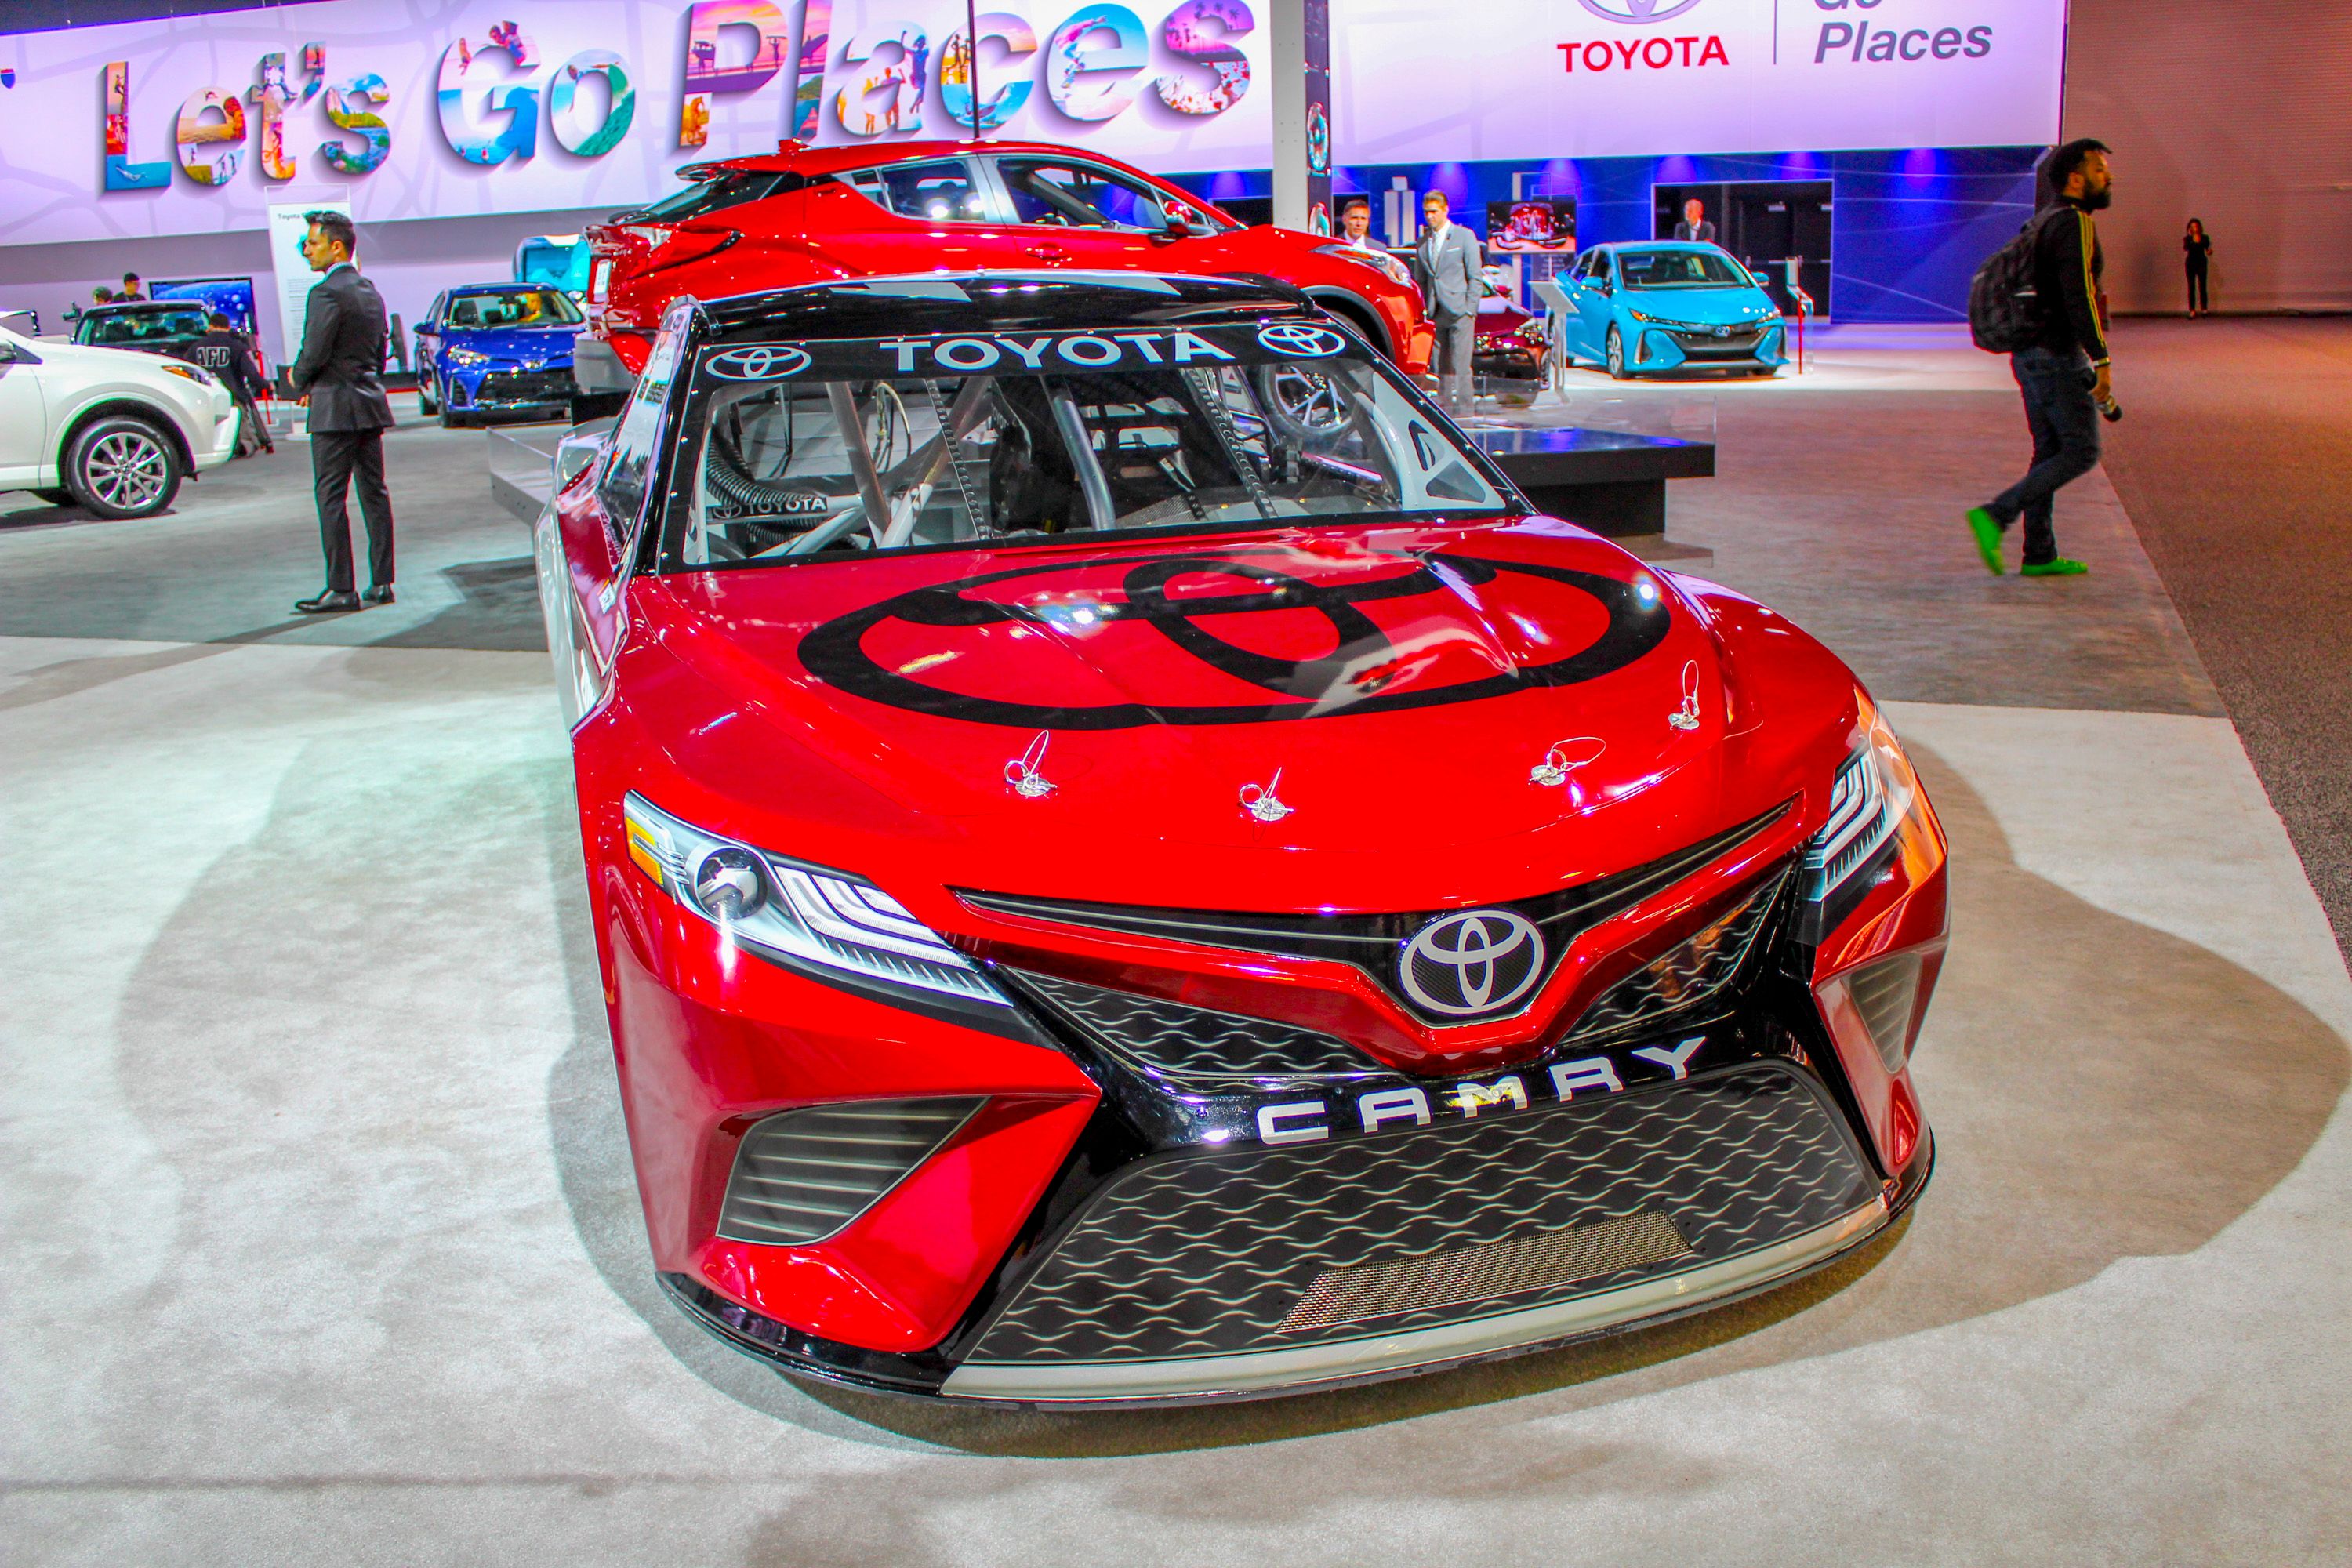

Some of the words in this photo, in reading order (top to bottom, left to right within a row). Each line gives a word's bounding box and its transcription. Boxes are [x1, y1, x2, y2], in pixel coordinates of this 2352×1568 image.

[1556, 35, 1730, 72] TOYOTA
[1814, 20, 1993, 64] Places
[104, 42, 390, 191] Let's
[437, 30, 636, 165] Go
[679, 0, 1255, 147] Places
[879, 332, 1236, 372] TOYOTA
[745, 497, 826, 514] TOYOTA
[1256, 1036, 1708, 1145] CAMRY
